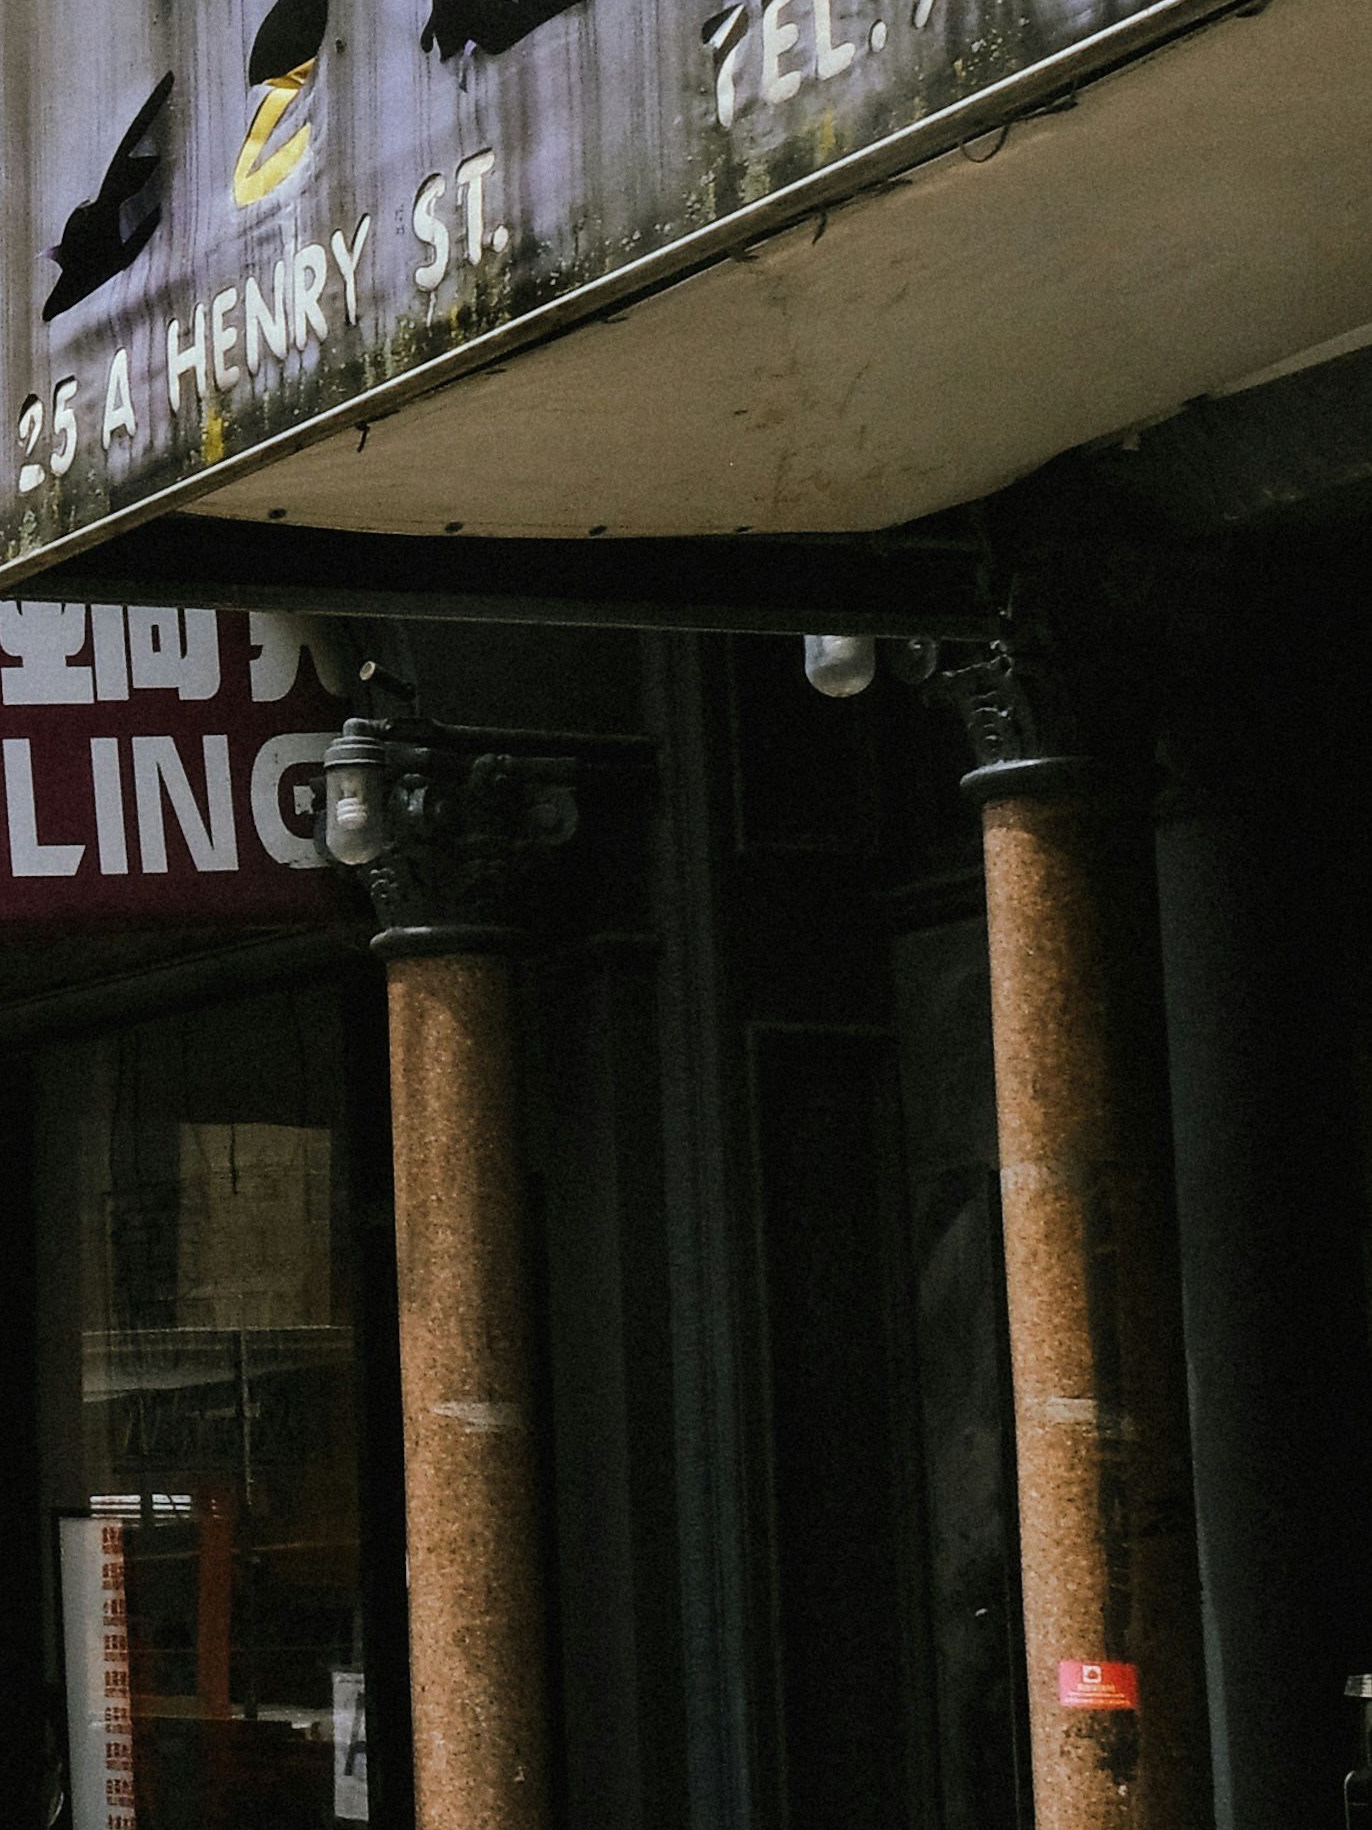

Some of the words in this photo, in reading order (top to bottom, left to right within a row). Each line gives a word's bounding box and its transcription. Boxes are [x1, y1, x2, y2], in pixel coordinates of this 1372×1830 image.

[18, 374, 78, 493] 25
[102, 347, 137, 450] A
[167, 212, 371, 414] HENRY
[412, 146, 510, 292] ST.
